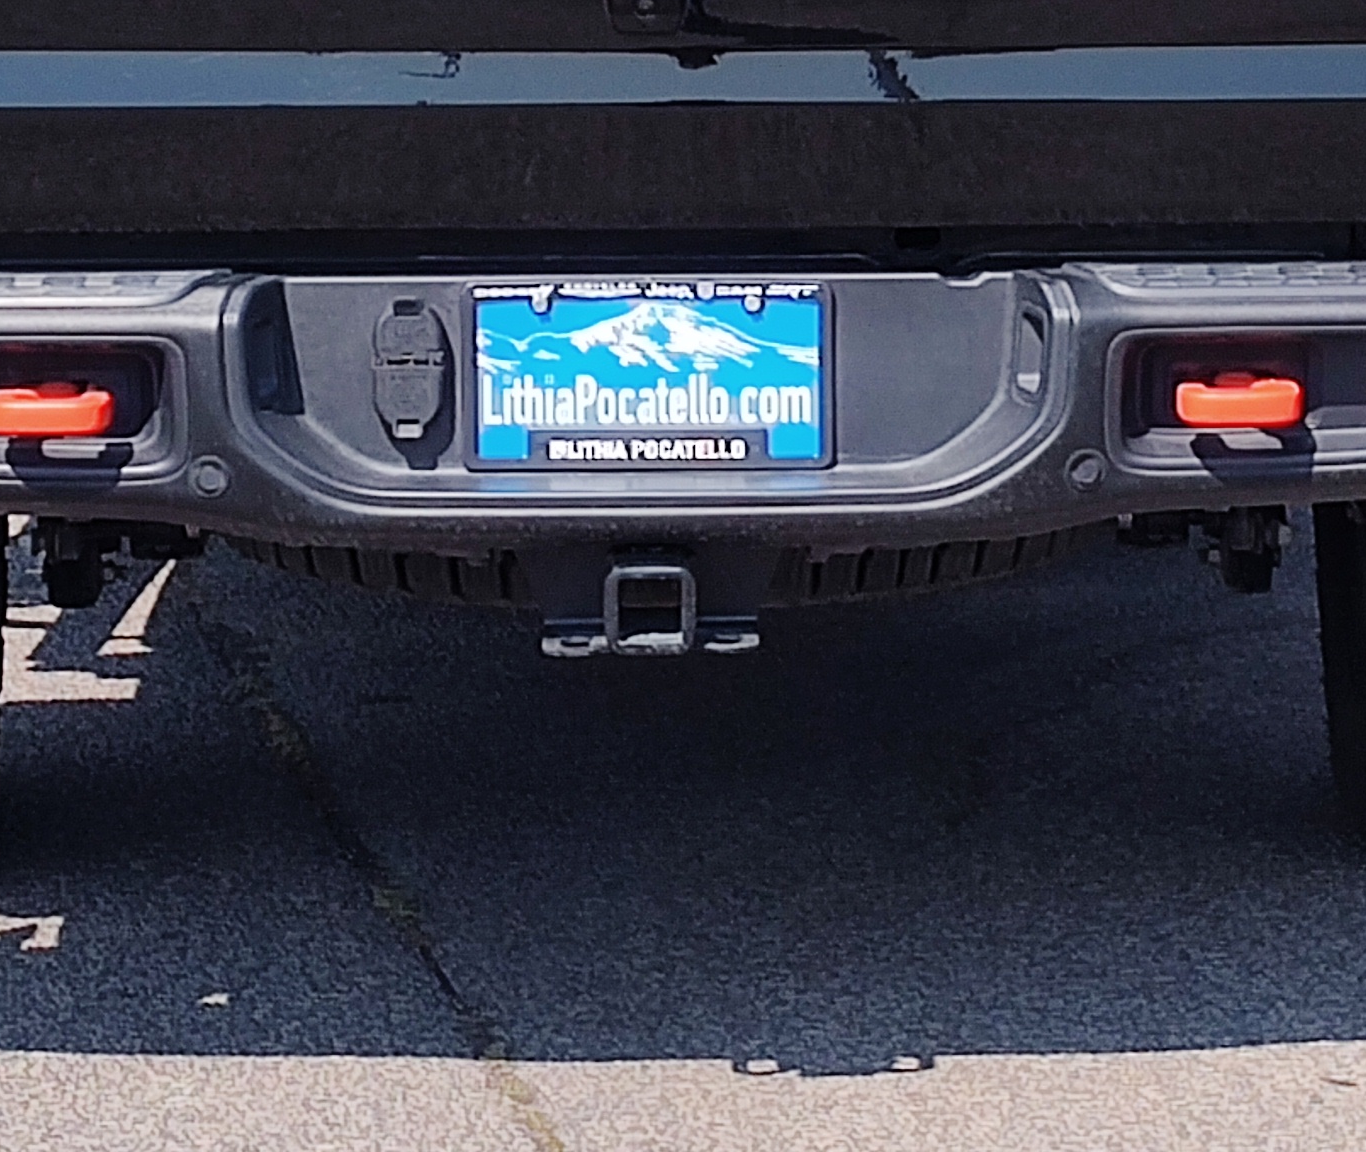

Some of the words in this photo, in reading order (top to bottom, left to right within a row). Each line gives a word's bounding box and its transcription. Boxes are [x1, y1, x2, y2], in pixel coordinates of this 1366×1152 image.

[482, 373, 812, 426] LithiaPocatello.com
[568, 439, 628, 460] LITHIA
[630, 439, 746, 460] POCATELLO
